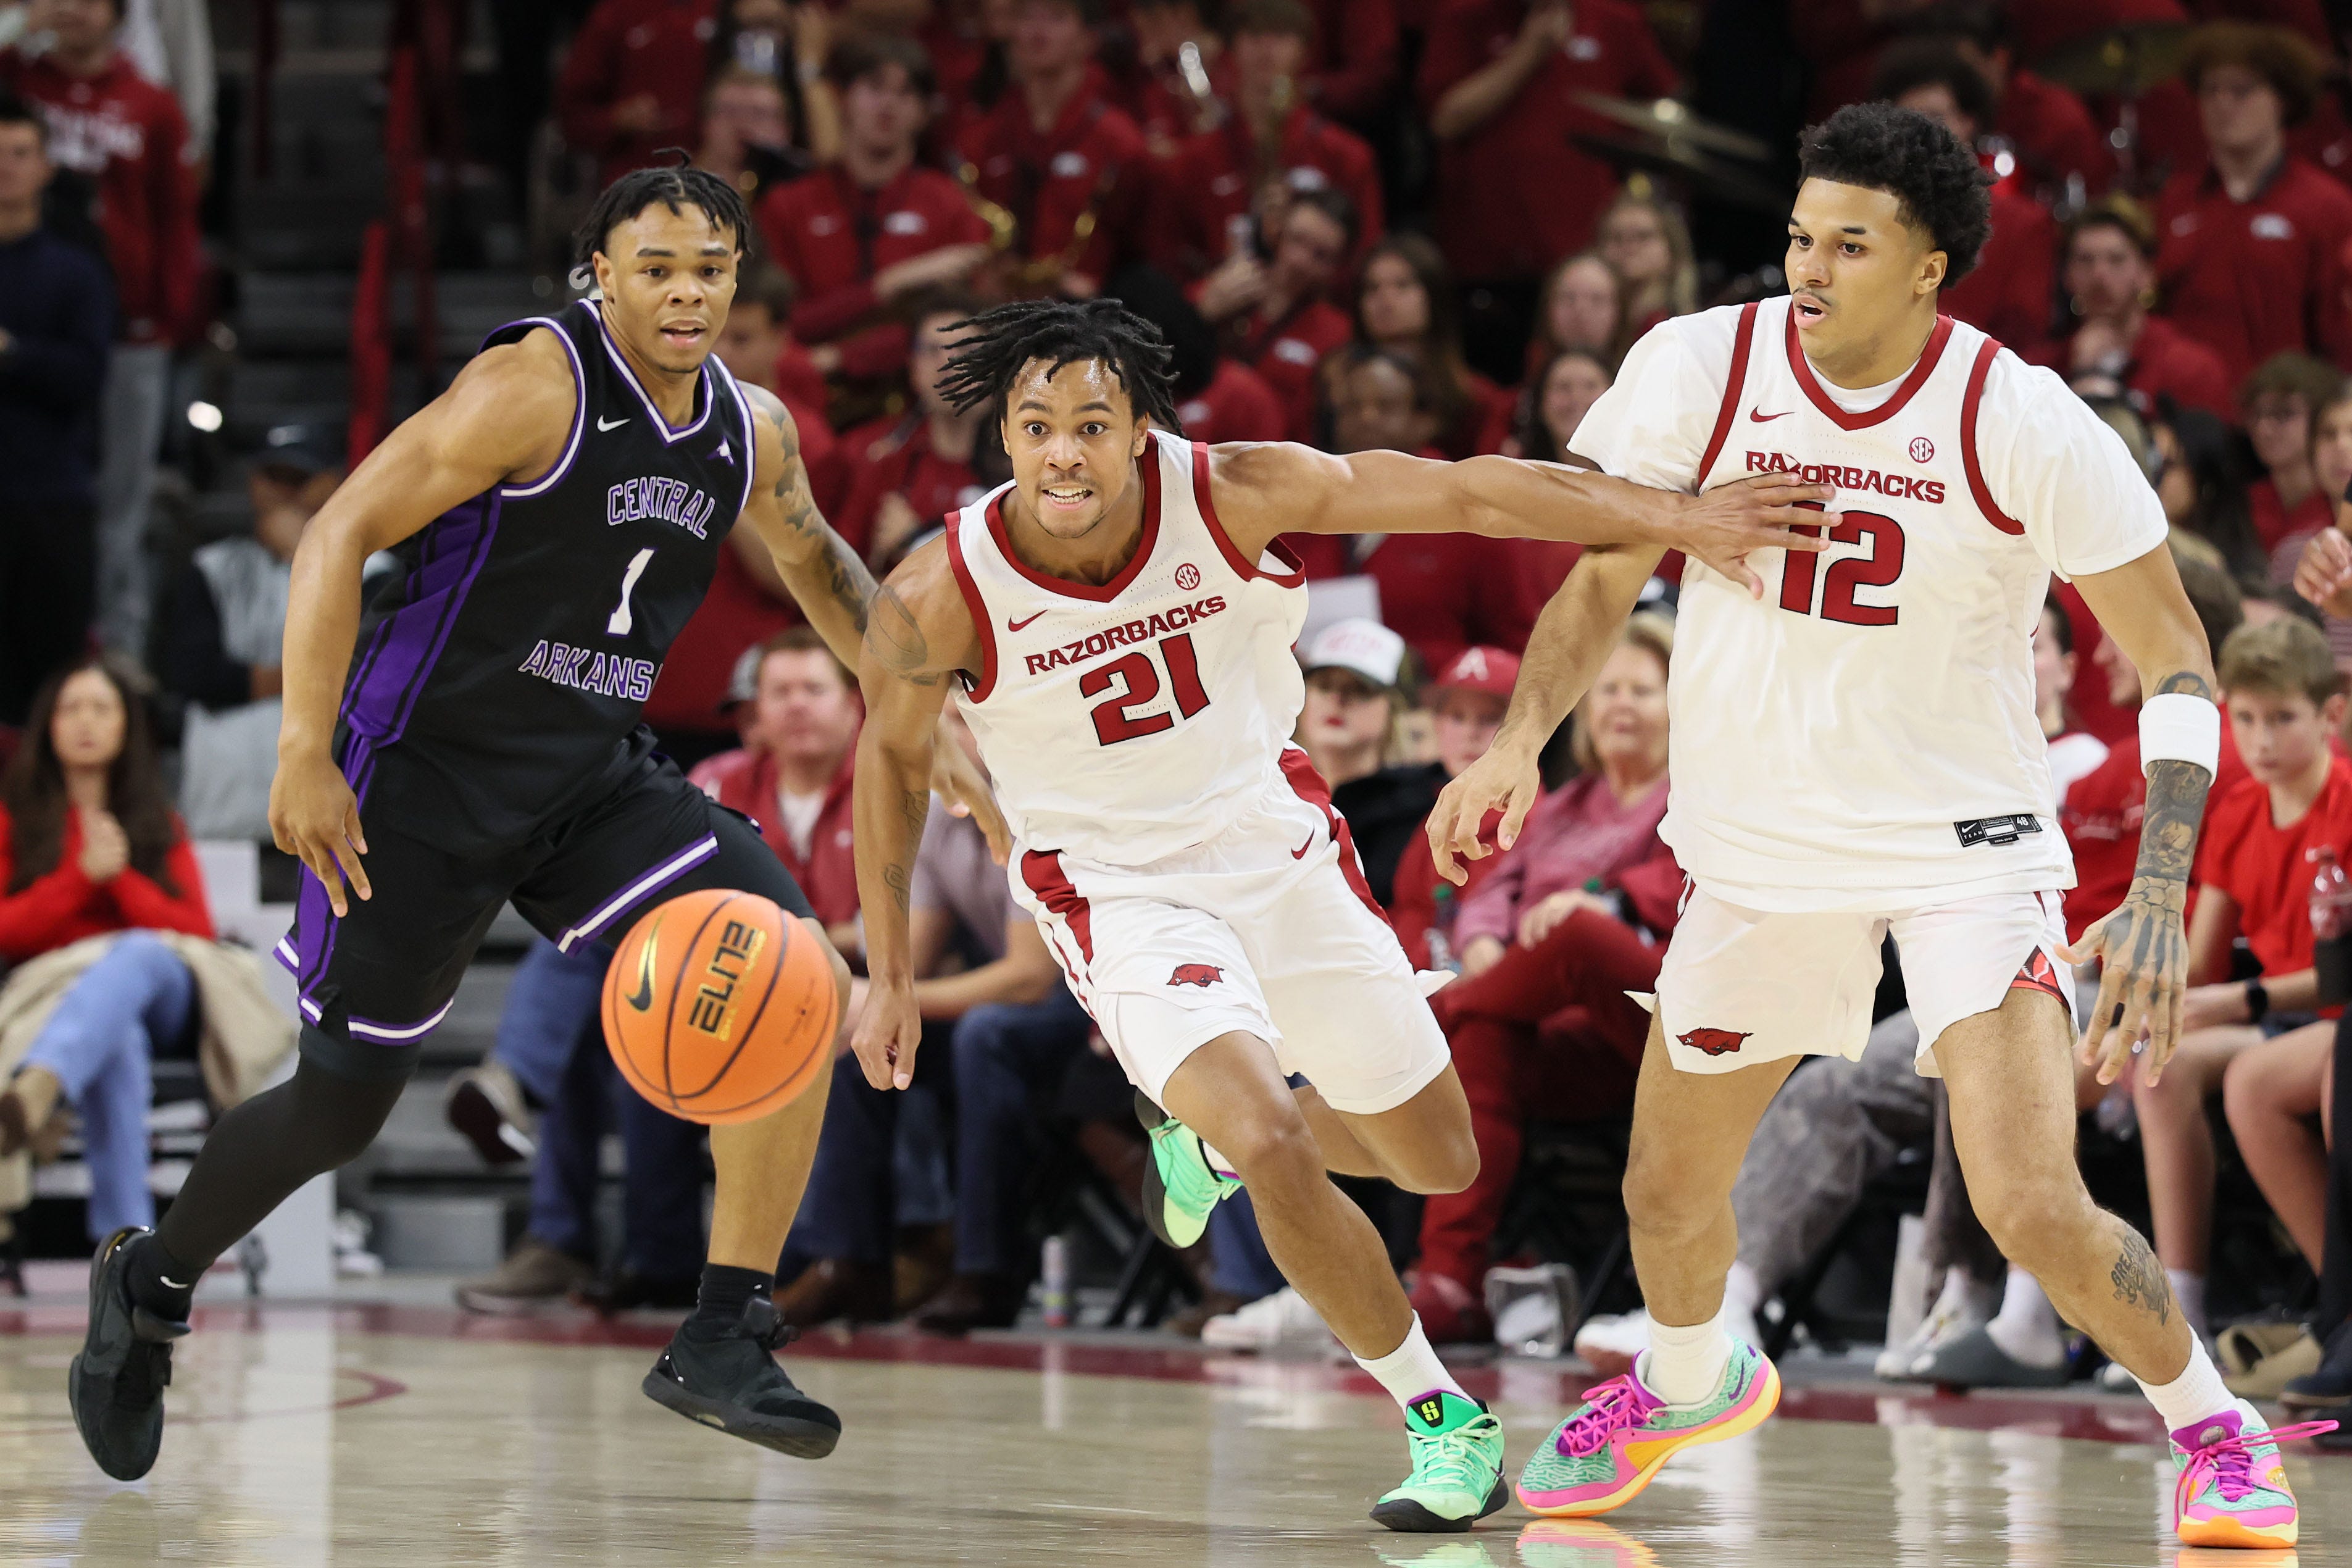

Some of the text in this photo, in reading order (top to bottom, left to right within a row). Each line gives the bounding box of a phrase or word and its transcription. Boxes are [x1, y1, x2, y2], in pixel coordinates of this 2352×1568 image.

[1910, 438, 1933, 462] SEC
[607, 476, 715, 540] CENTRAL
[605, 547, 657, 638] 1
[1176, 564, 1199, 590] SEC
[1779, 501, 1905, 626] 12
[1024, 596, 1226, 675] RAZORBACKS
[518, 640, 664, 702] ARKANS
[1079, 632, 1211, 746] 21
[1964, 830, 1983, 840] TEAM
[2016, 816, 2029, 826] 48
[687, 920, 756, 1034] ELITE
